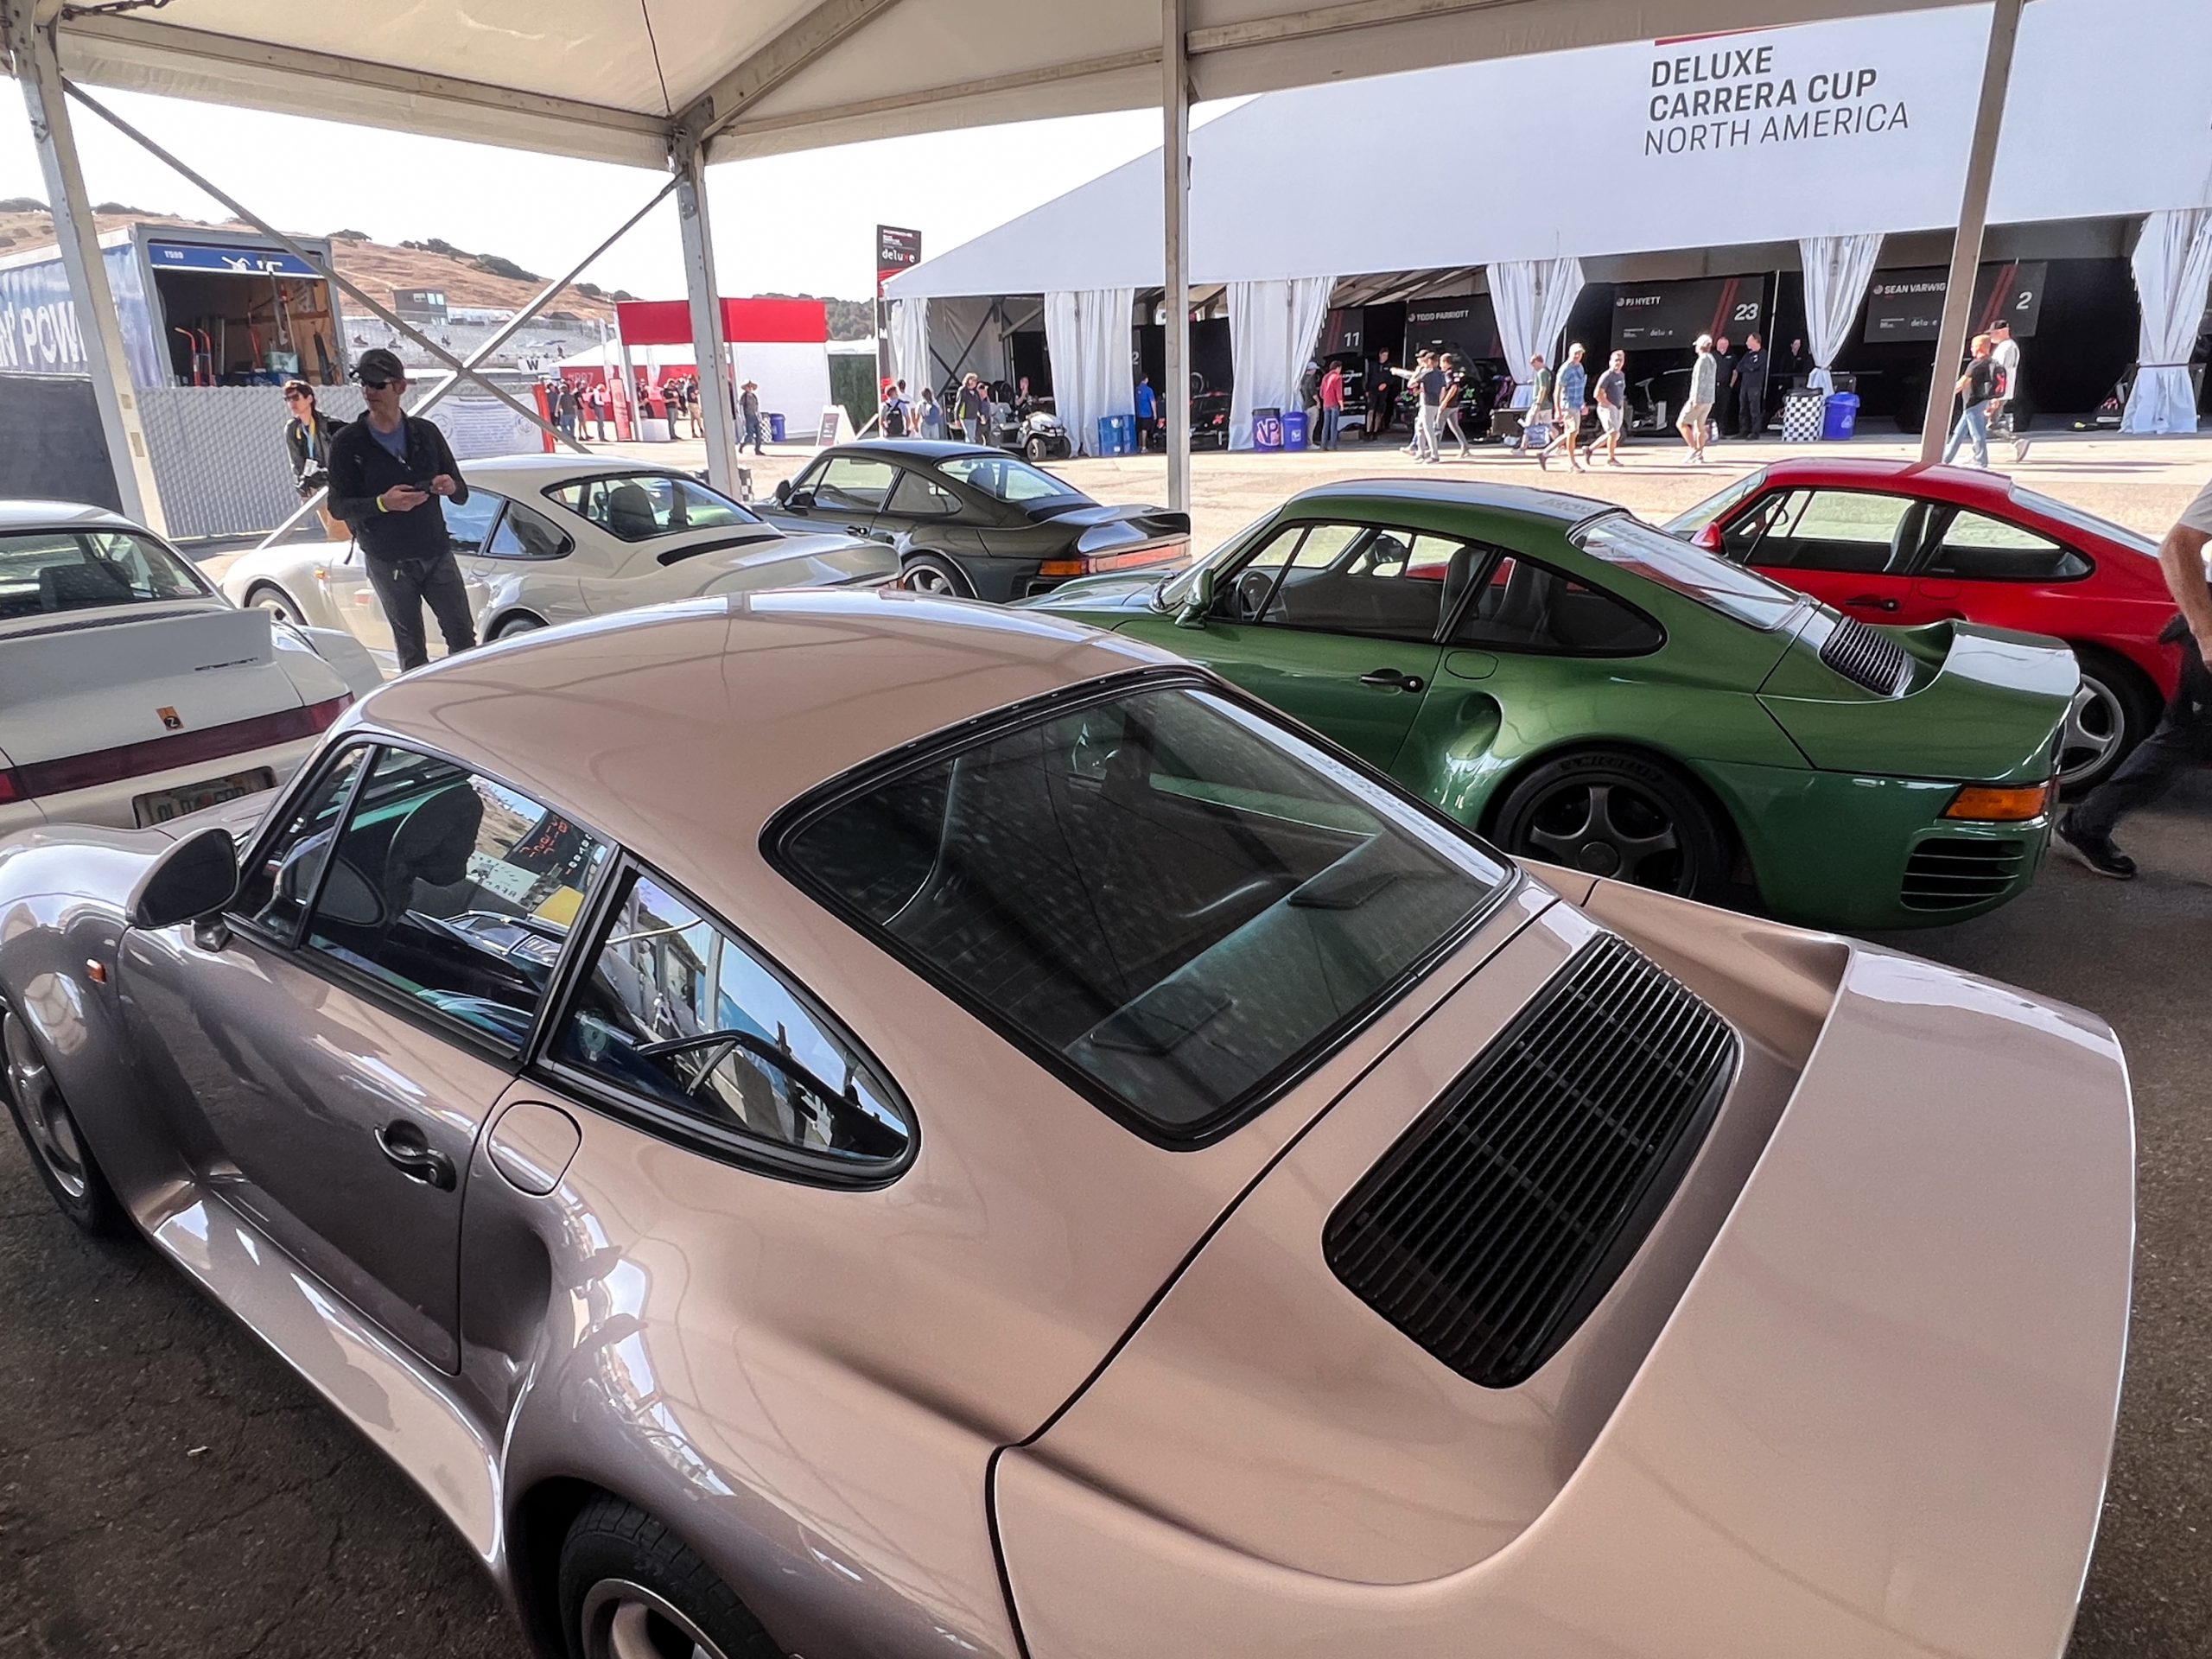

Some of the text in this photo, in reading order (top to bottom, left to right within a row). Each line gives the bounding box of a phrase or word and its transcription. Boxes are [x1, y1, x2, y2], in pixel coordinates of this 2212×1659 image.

[1651, 45, 1773, 87] DELUXE
[1649, 68, 1877, 122] CARRERA CUP
[1644, 101, 1909, 156] NORTH AMERICA
[1885, 284, 1909, 295] SEAN
[2016, 291, 2032, 310] 2
[1734, 302, 1759, 321] 23
[1344, 332, 1360, 346] 11
[526, 359, 538, 371] W
